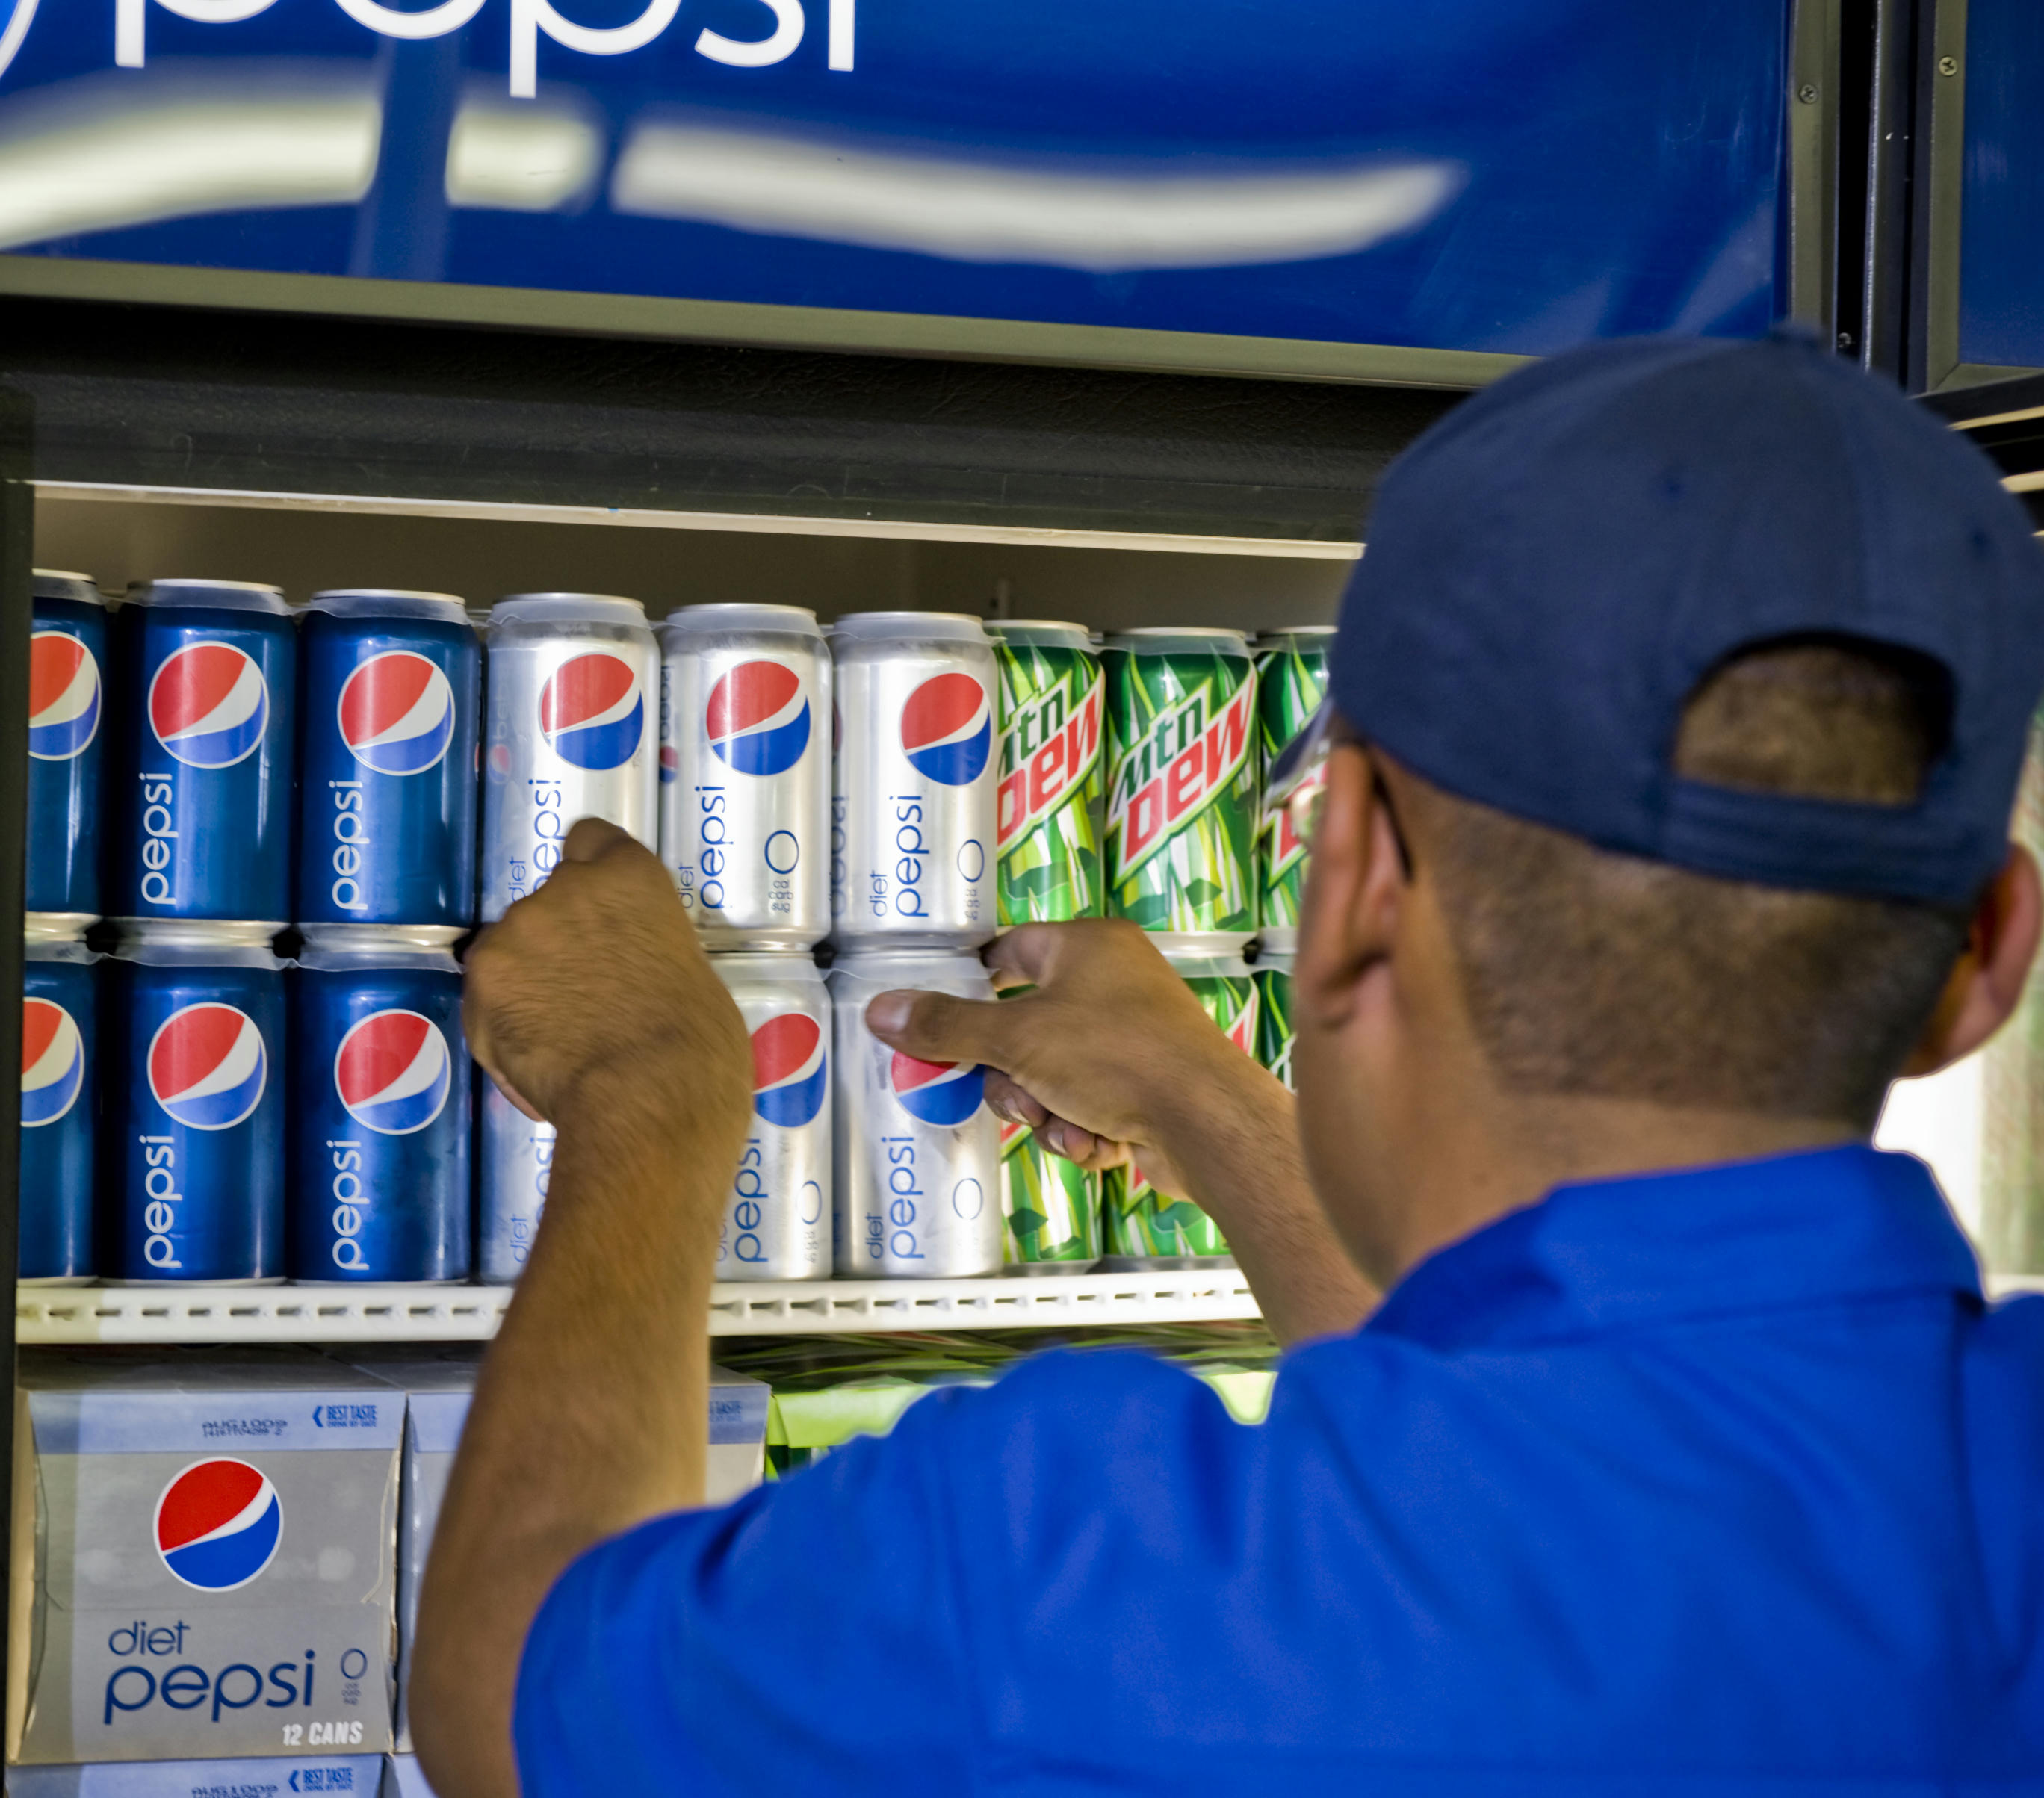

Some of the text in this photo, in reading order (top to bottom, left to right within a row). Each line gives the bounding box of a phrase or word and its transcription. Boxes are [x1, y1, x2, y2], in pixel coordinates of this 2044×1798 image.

[139, 772, 178, 905] pepsi
[329, 781, 370, 911] pepsi
[678, 863, 694, 909] diet
[695, 786, 734, 909] pepsi
[889, 796, 930, 917] pepsi
[870, 870, 888, 917] diet
[139, 1135, 182, 1268] pepsi
[326, 1140, 370, 1270] pepsi
[510, 1214, 529, 1263] diet
[865, 1212, 883, 1259] diet
[881, 1136, 925, 1259] pepsi
[108, 1620, 190, 1655] diet
[103, 1649, 316, 1726] pepsi
[282, 1720, 364, 1746] 12 CANS
